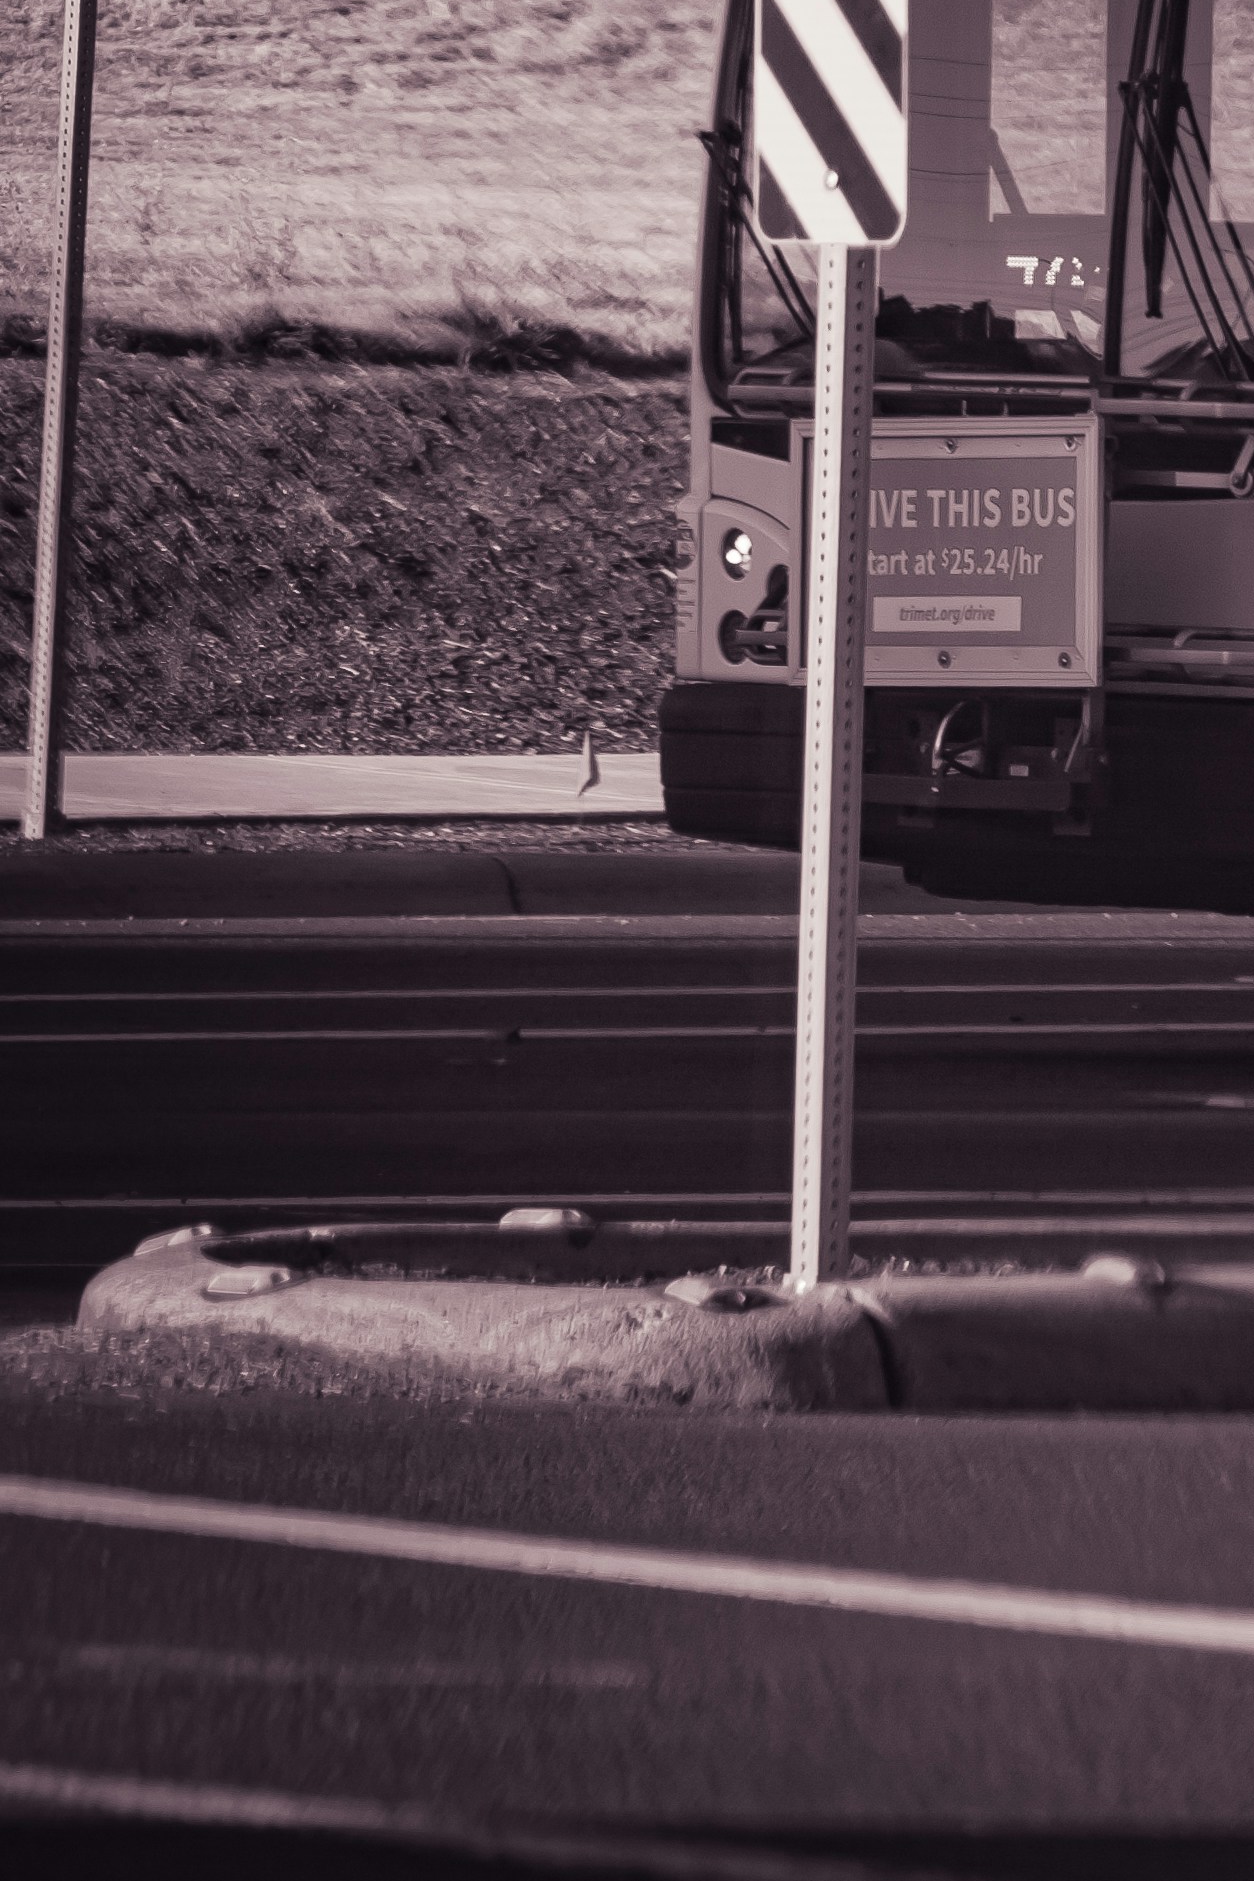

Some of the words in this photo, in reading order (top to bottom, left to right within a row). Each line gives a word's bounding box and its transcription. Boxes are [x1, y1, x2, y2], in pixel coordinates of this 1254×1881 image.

[869, 489, 918, 528] IVE
[926, 488, 1001, 528] THIS
[1011, 487, 1076, 528] BUS
[867, 549, 908, 575] tart
[914, 549, 936, 575] at
[941, 546, 1043, 581] $25.24/hr
[900, 604, 995, 625] trimet.org/drive
